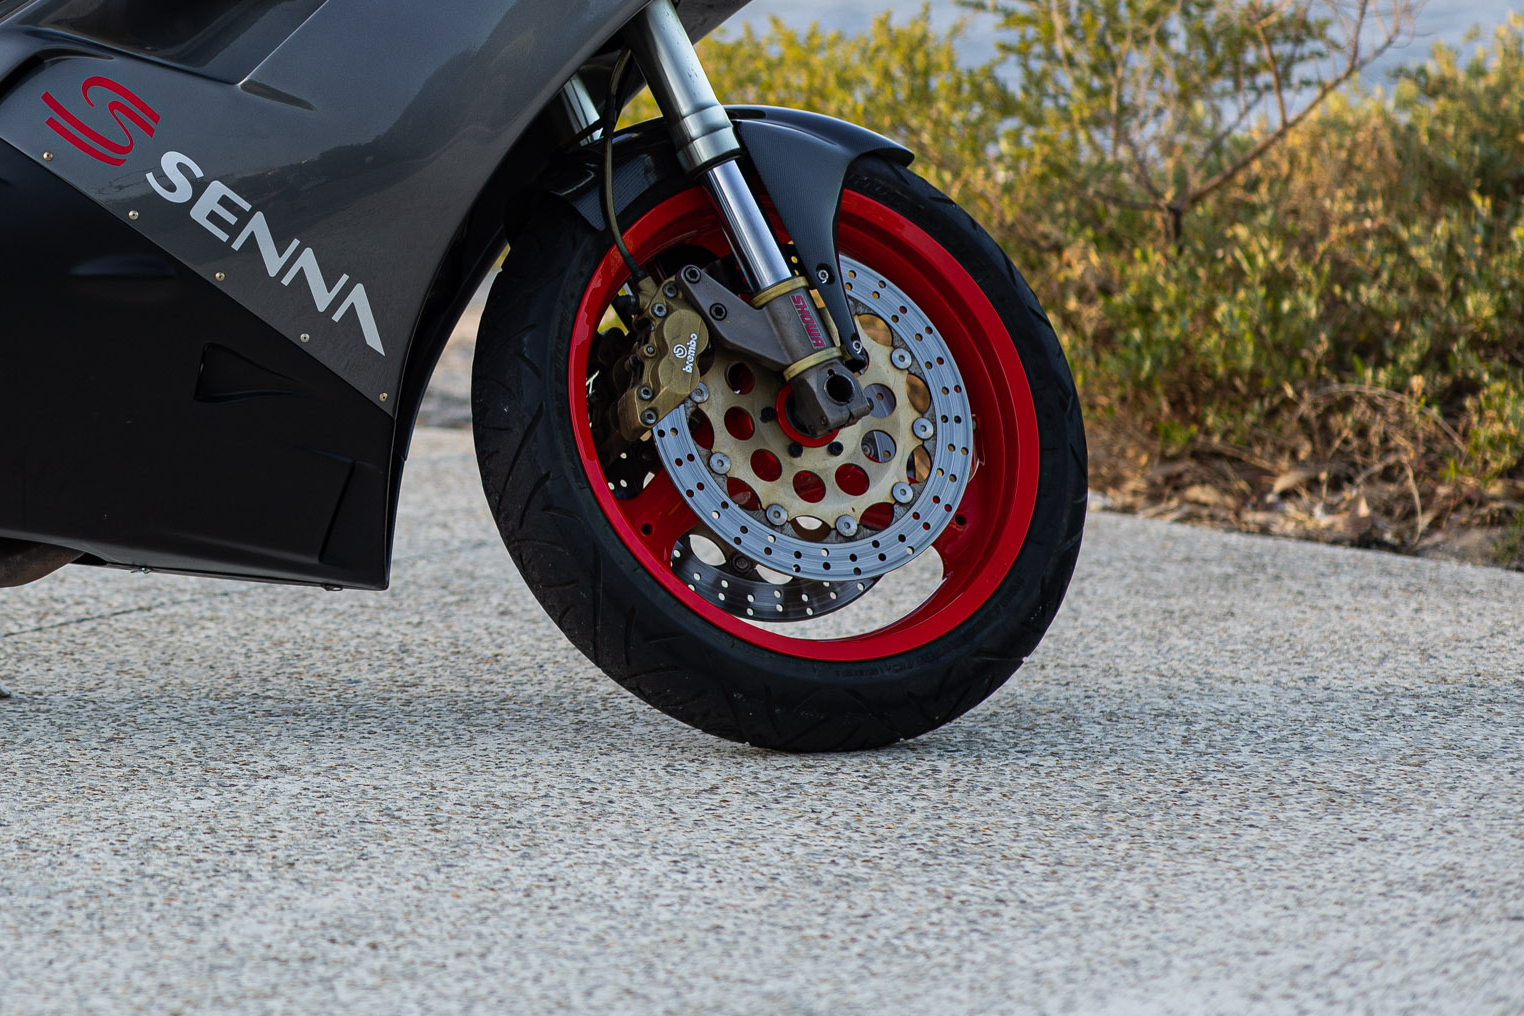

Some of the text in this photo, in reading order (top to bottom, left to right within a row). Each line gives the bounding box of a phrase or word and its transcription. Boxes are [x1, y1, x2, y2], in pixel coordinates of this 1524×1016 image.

[146, 151, 386, 357] SENNA
[791, 295, 825, 347] SHOWA
[682, 333, 698, 373] brembo
